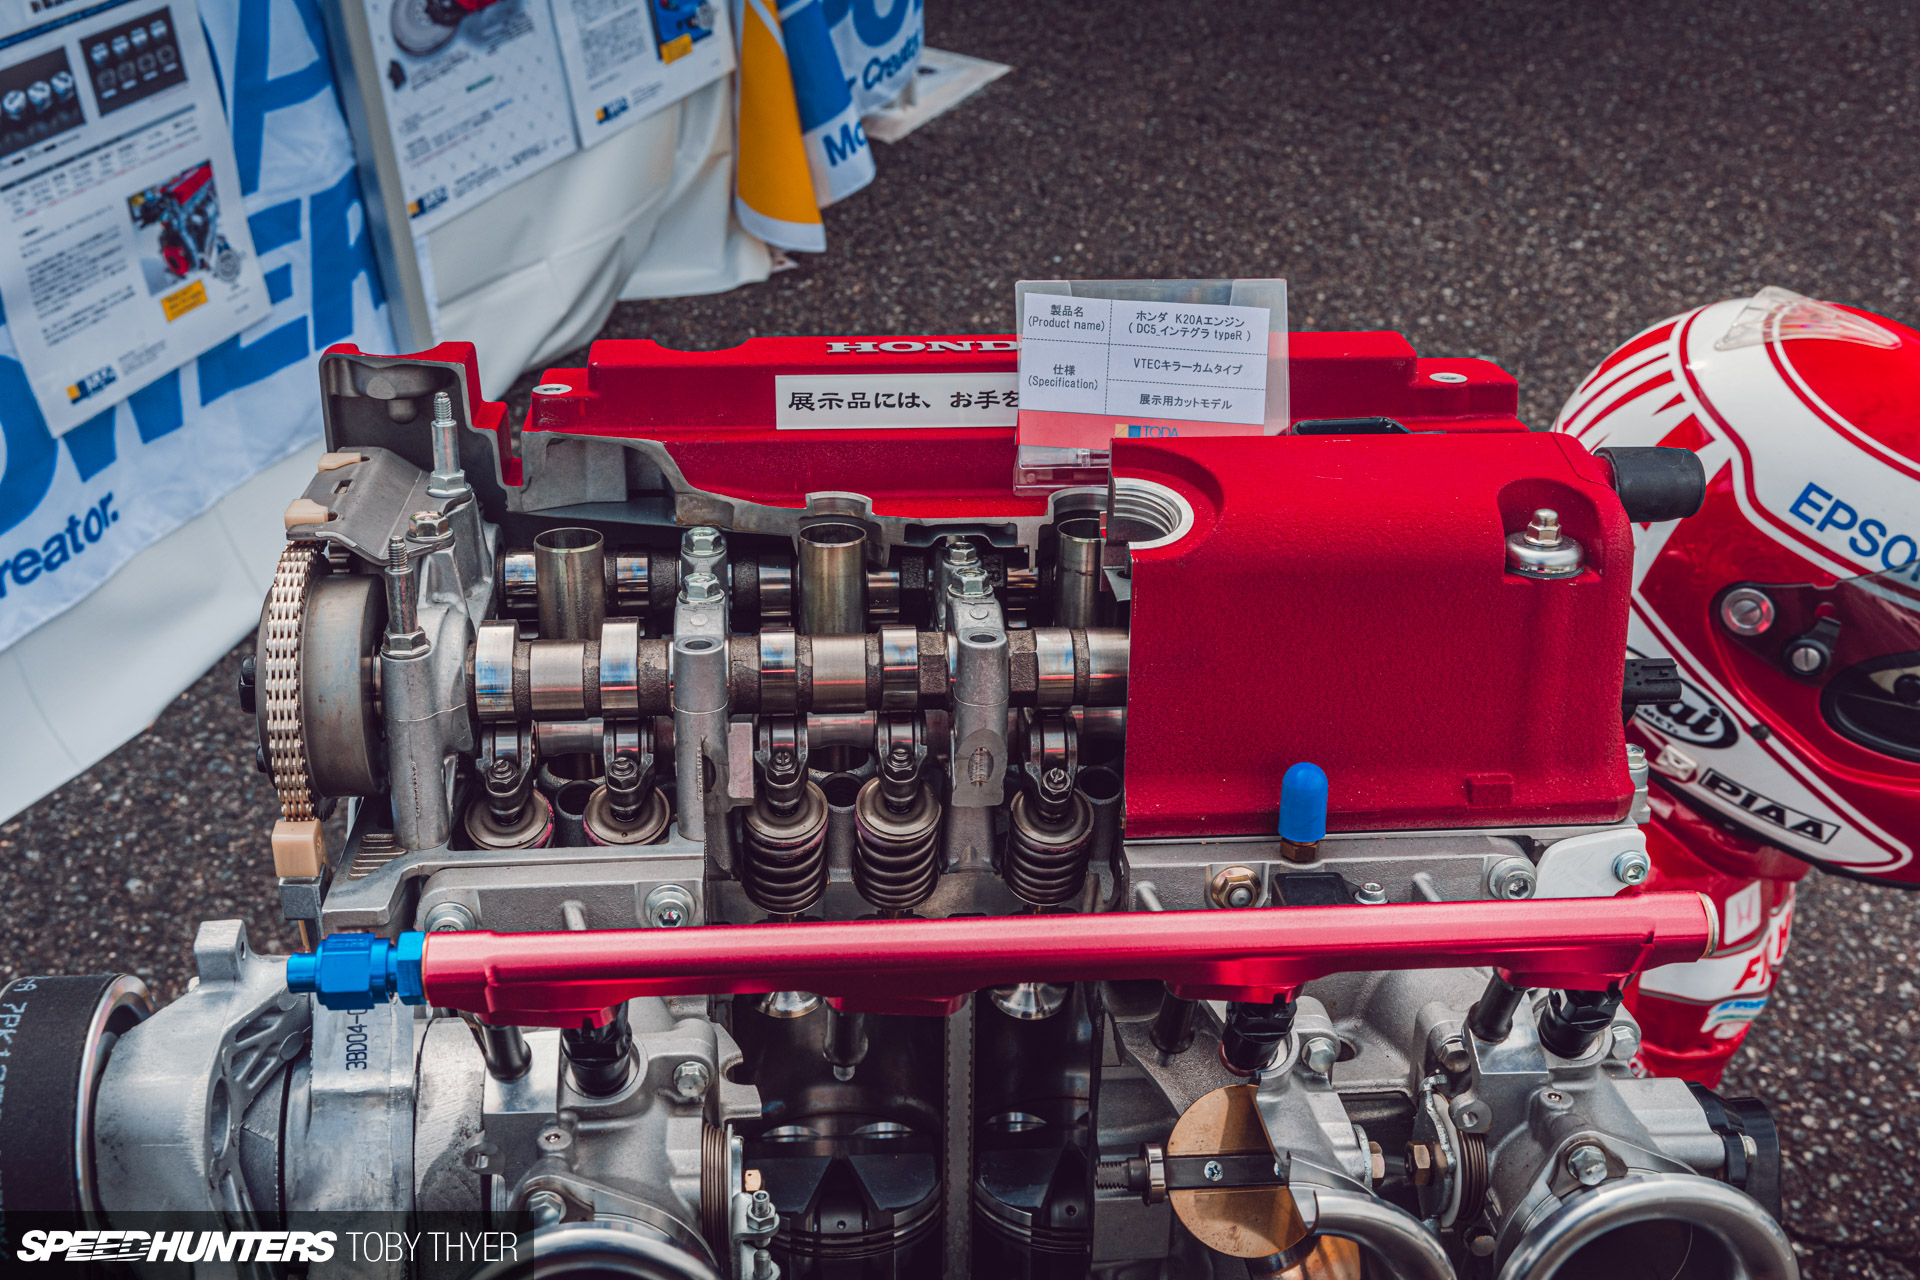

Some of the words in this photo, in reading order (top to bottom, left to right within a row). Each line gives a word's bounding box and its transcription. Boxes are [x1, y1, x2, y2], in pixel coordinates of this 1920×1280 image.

[1050, 304, 1084, 318] 製品名
[1136, 310, 1168, 323] ホンダ
[1175, 313, 1245, 328] K20Aエンジン
[1028, 315, 1070, 329] (Product
[1073, 320, 1105, 332] name)
[1053, 363, 1076, 376] 仕様
[1133, 358, 1244, 375] VTECキラーカムタイプ
[1028, 375, 1098, 391] (Specification)
[788, 391, 932, 411] 展示品には、
[1139, 393, 1233, 410] 展示用カットモデル
[1142, 425, 1178, 438] TODA
[1788, 481, 1920, 583] EPSO
[1704, 773, 1823, 840] PIAA
